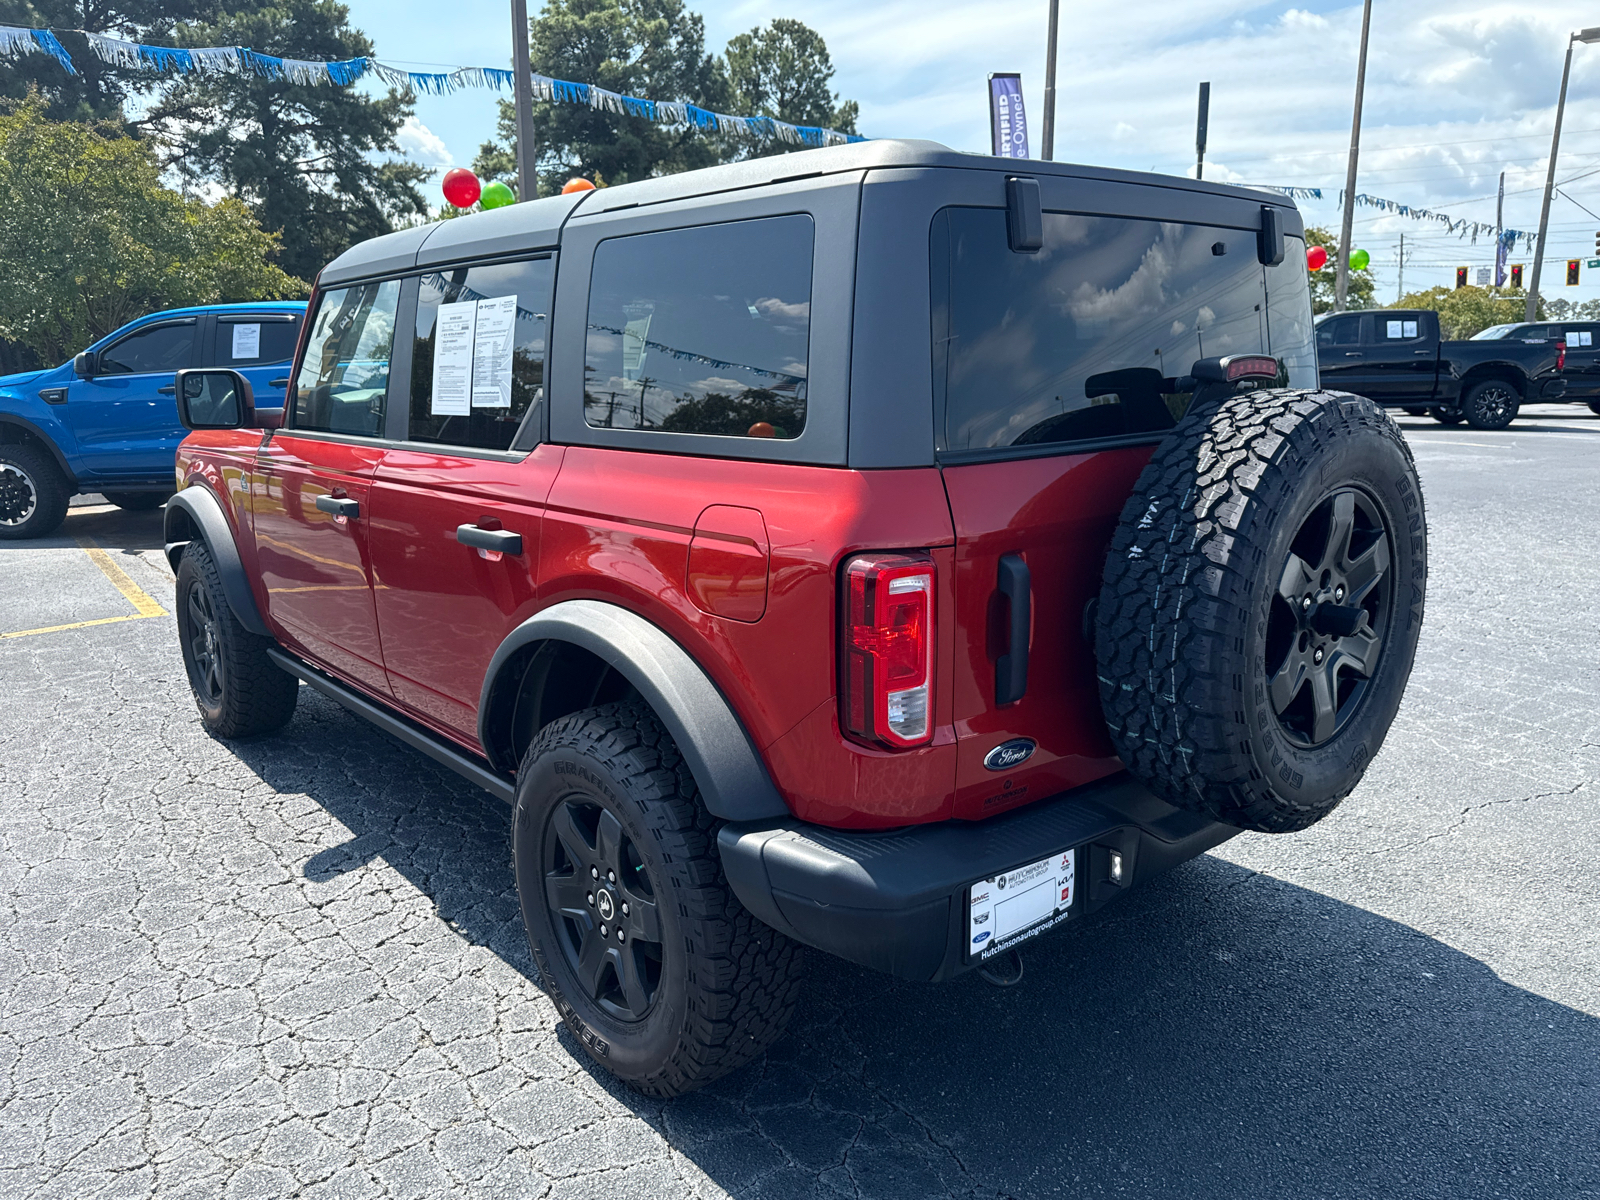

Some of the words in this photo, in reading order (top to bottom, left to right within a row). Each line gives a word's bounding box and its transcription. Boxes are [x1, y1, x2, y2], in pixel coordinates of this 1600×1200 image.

[1396, 473, 1424, 632] GENERAL
[998, 745, 1027, 766] Ford
[1254, 655, 1304, 790] GRABBER
[553, 759, 642, 842] GRABBER
[971, 892, 990, 905] GMC
[981, 911, 1069, 960] Hutchinsonautogroup.com
[534, 941, 611, 1058] GENERAL
